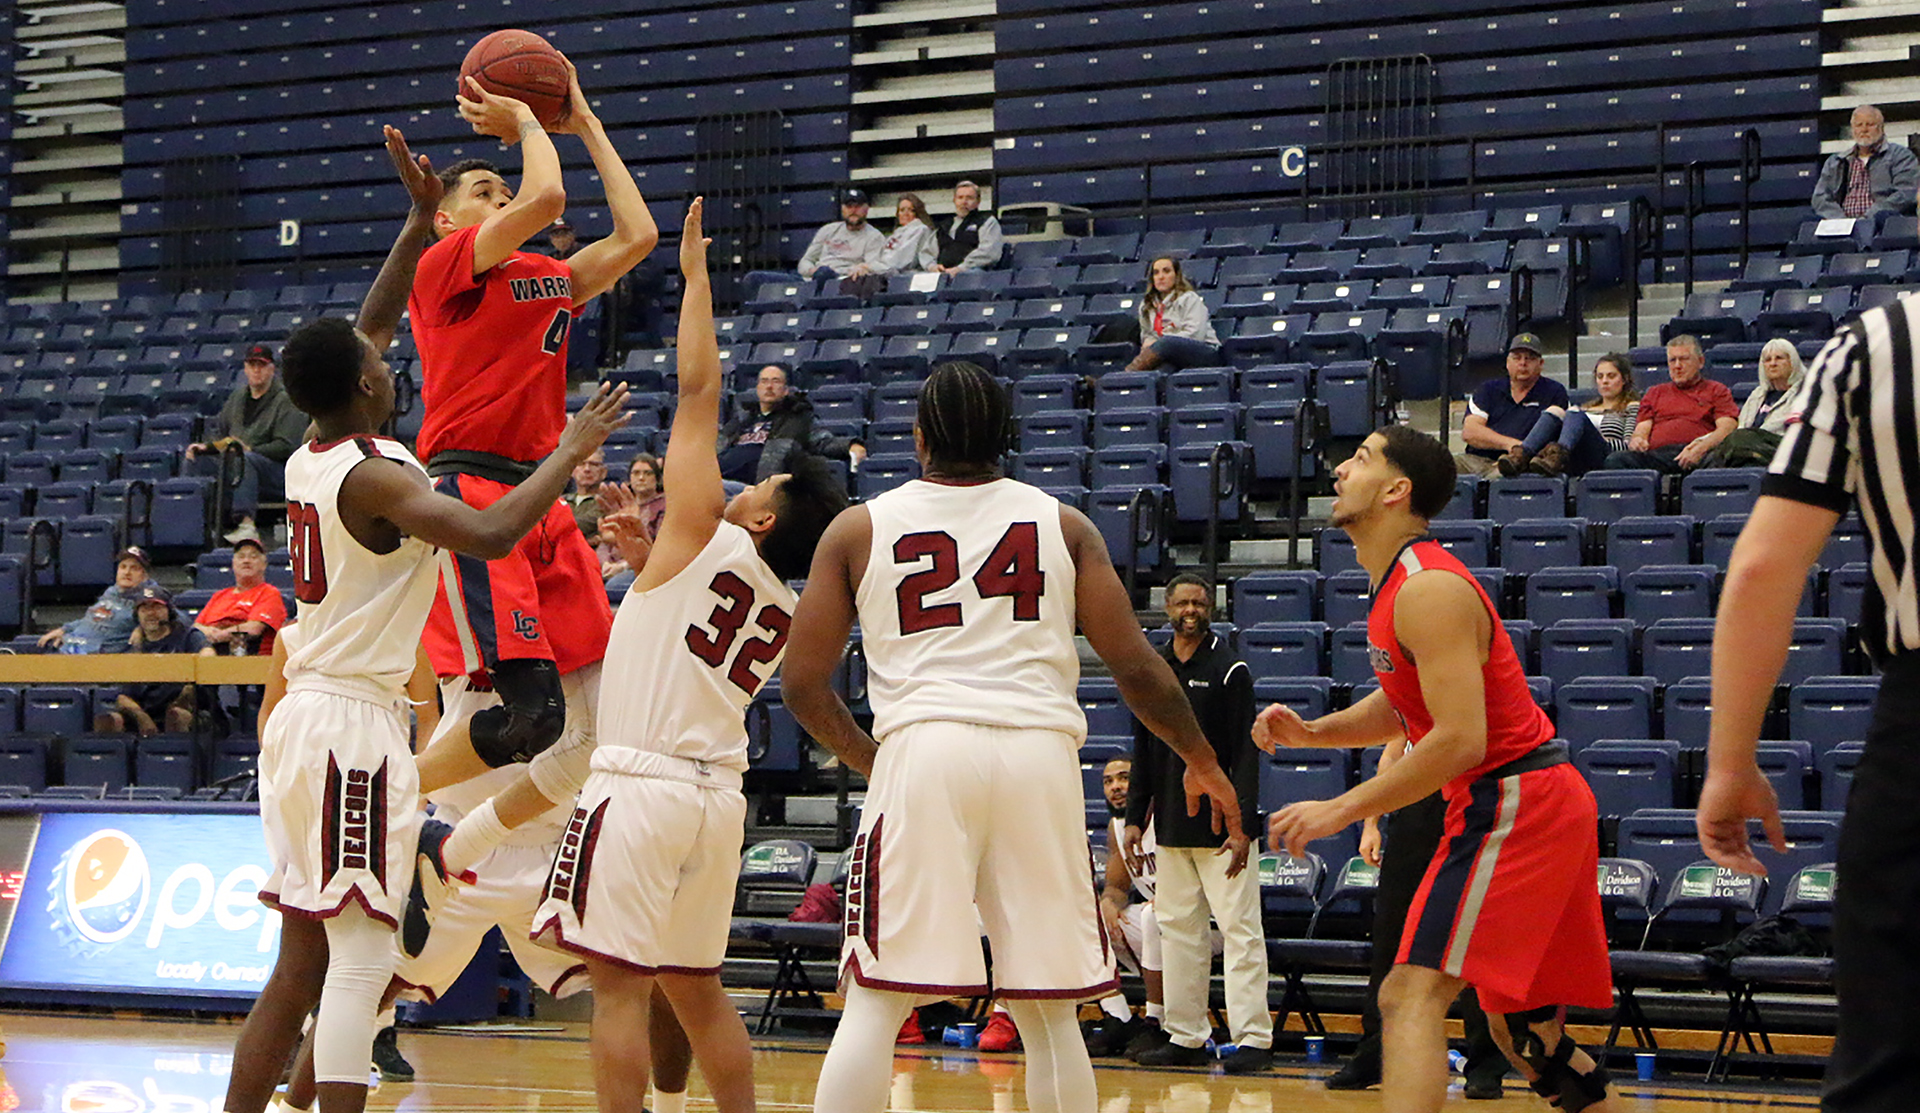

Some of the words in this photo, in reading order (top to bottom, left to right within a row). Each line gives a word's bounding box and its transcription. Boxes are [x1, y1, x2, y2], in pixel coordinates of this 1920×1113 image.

[1281, 147, 1304, 177] C
[281, 220, 299, 246] D
[892, 521, 1046, 637] 24
[511, 610, 540, 641] LC
[684, 570, 793, 698] 32
[342, 768, 370, 870] BEACONS
[551, 807, 588, 902] BEACONS
[1715, 876, 1751, 886] Davidson
[156, 959, 208, 983] Locally
[211, 961, 269, 983] Owned
